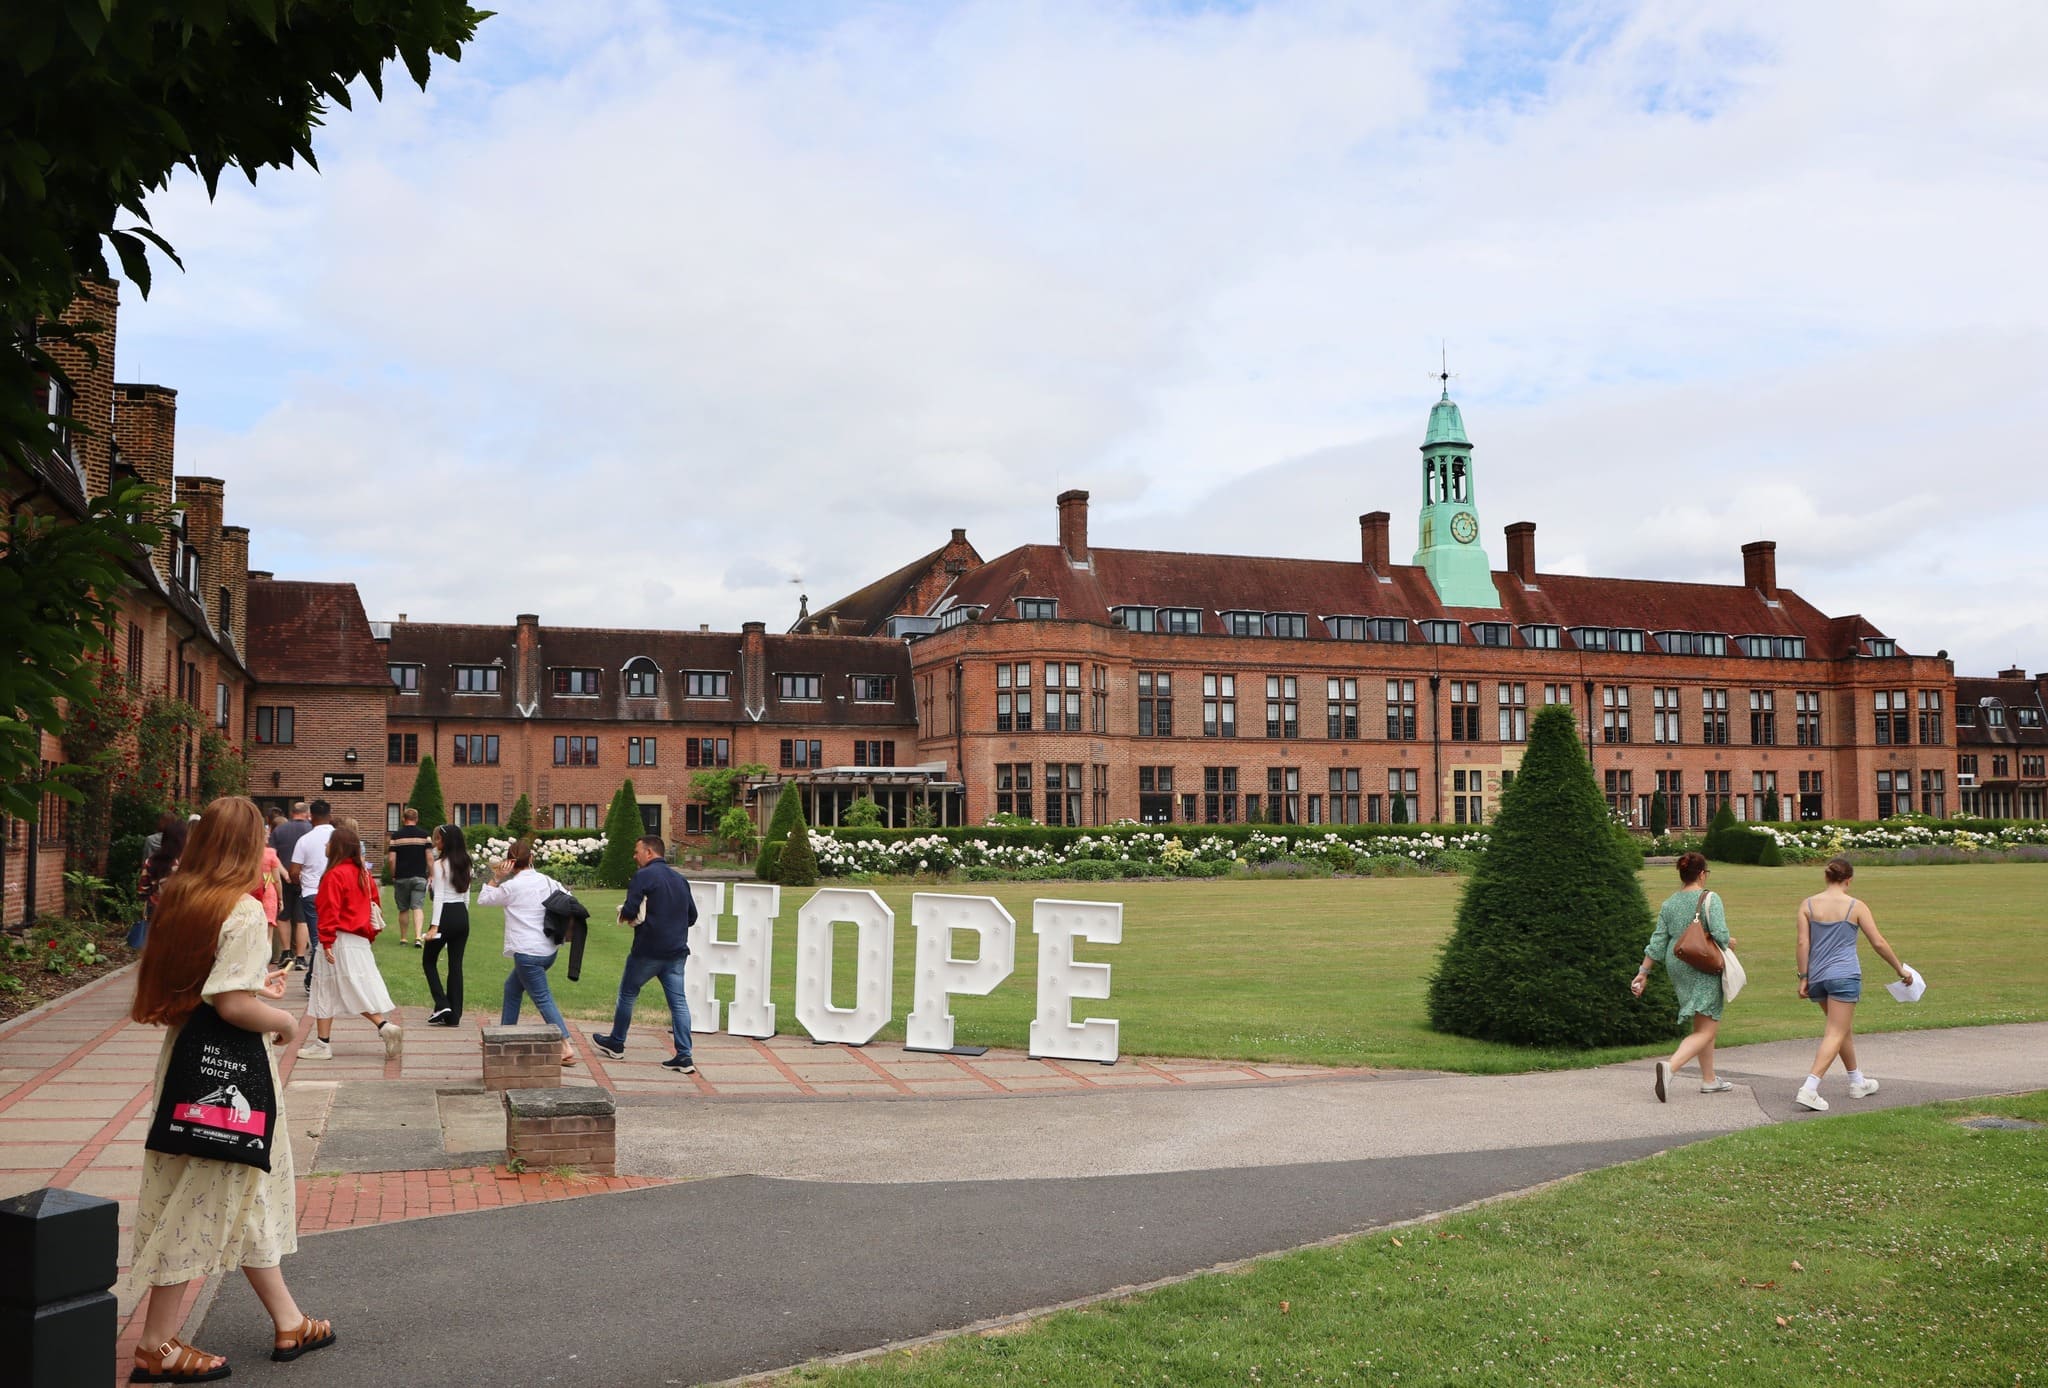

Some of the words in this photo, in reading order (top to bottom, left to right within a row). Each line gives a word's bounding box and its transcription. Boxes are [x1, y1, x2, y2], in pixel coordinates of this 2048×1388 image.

[684, 880, 1123, 1061] HOPE
[203, 1044, 221, 1055] HIS
[201, 1055, 247, 1071] MASTER'S
[200, 1066, 230, 1079] VOICE
